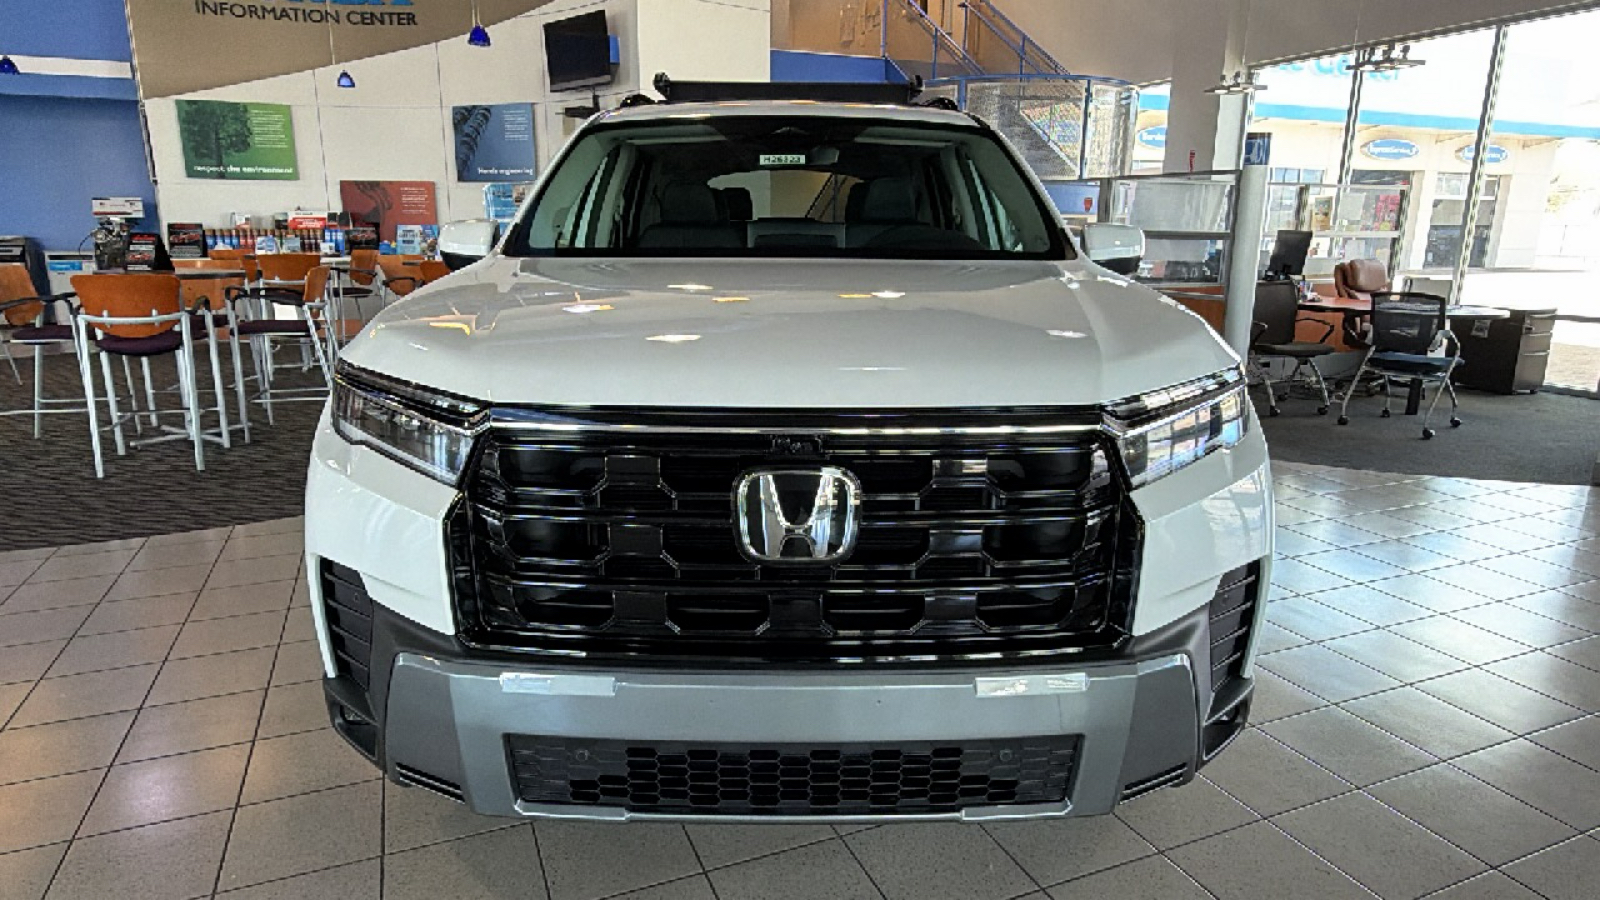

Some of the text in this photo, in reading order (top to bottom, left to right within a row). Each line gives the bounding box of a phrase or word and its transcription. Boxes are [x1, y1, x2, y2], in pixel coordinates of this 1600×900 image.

[195, 0, 418, 26] INFORMATION CENTER
[194, 164, 293, 174] respect the environment
